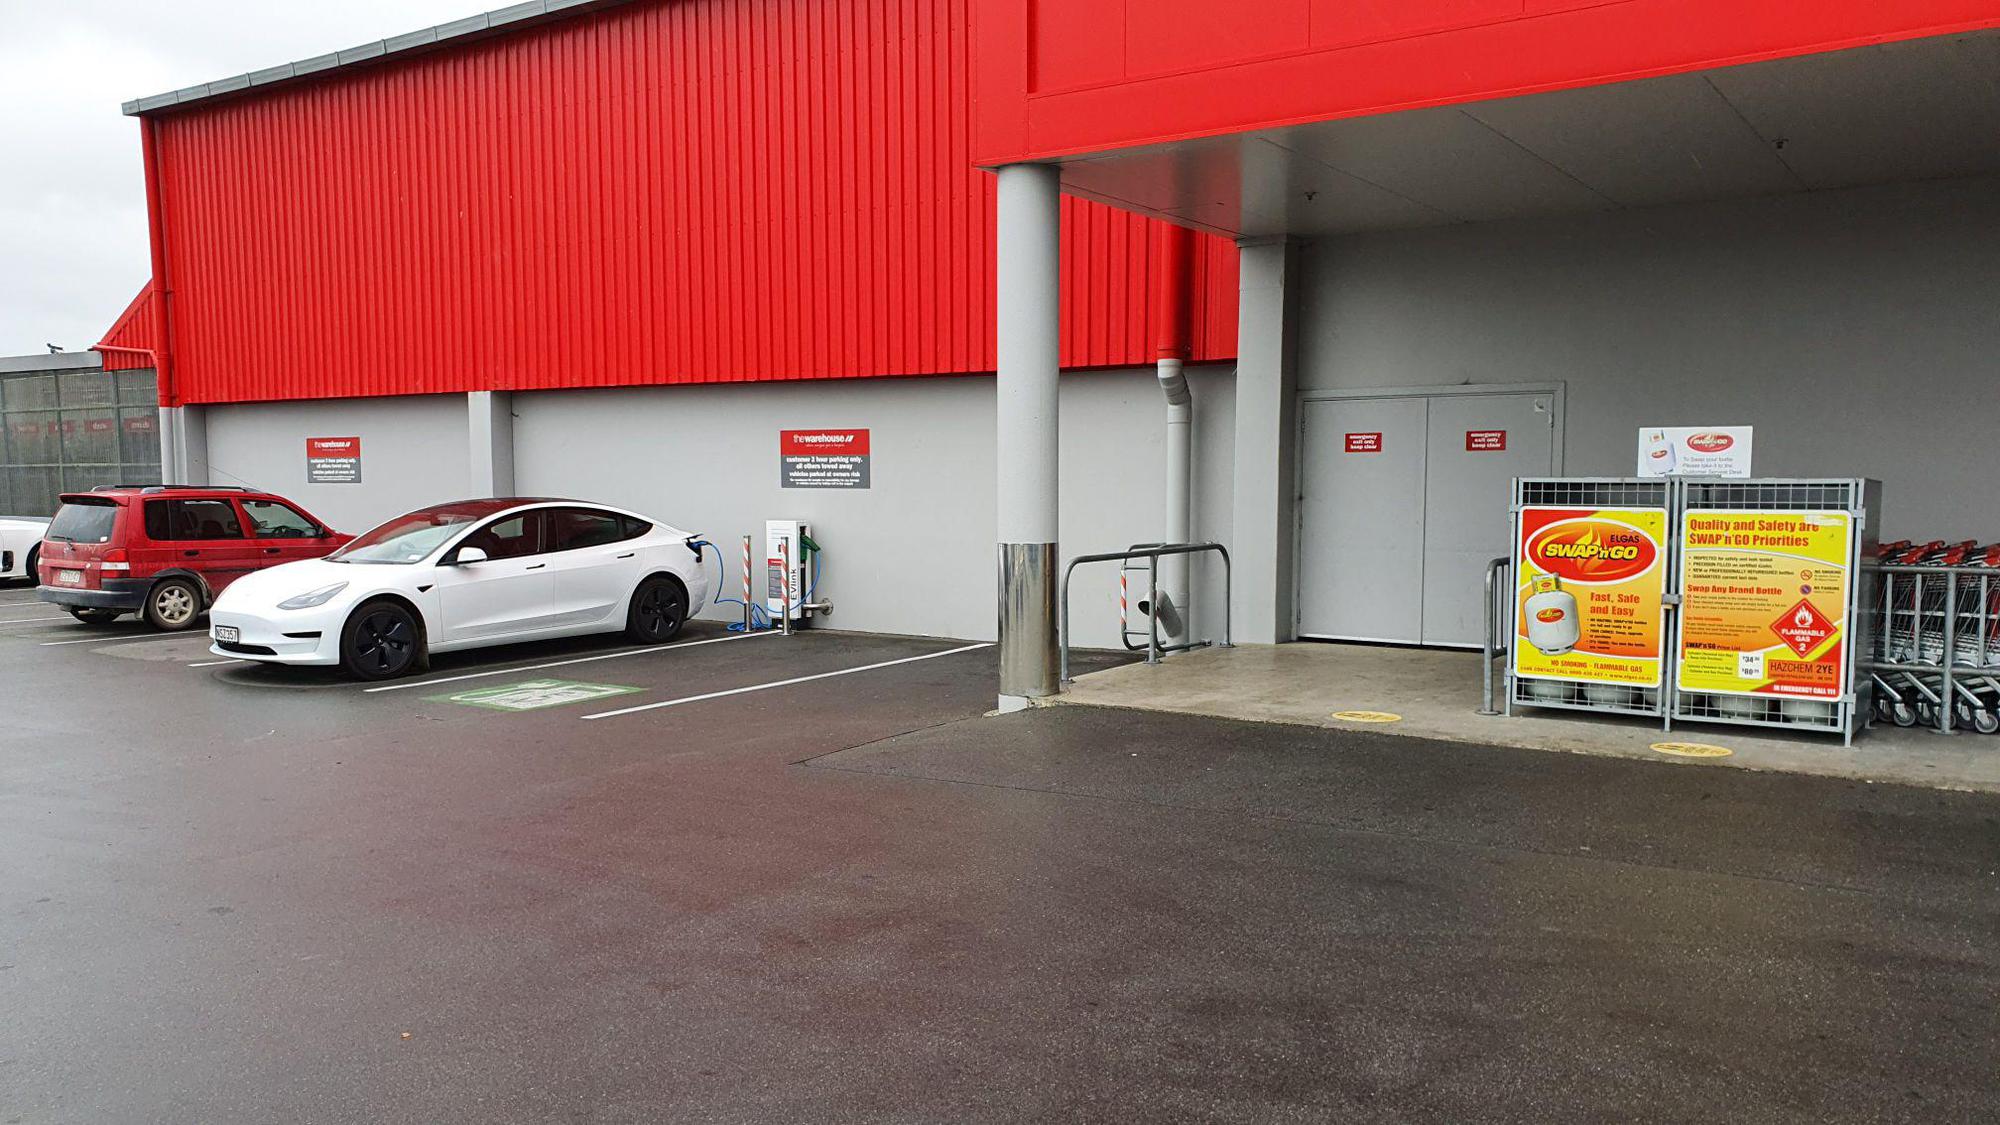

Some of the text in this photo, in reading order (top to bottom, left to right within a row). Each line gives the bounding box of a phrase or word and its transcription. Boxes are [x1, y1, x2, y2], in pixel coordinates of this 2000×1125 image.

[828, 456, 849, 464] parking
[1689, 519, 1819, 533] Quality and Safety are
[1610, 534, 1640, 543] ELGAS
[1753, 534, 1809, 547] Priorities
[1687, 584, 1782, 595] Swap Any Brand Bottle
[1590, 592, 1640, 603] Fast, Safe
[1590, 605, 1635, 617] and Easy
[1781, 628, 1825, 637] FLAMMABLE
[1795, 635, 1810, 643] GAS
[1799, 642, 1806, 651] 2
[1551, 659, 1559, 667] NO
[1560, 660, 1588, 668] SMOKING
[1593, 662, 1628, 672] FLAMMABLE
[1630, 665, 1643, 673] GAS
[1770, 662, 1813, 673] HAZCHEM
[1816, 664, 1834, 674] 2YE
[1780, 685, 1812, 694] EMERGENCY
